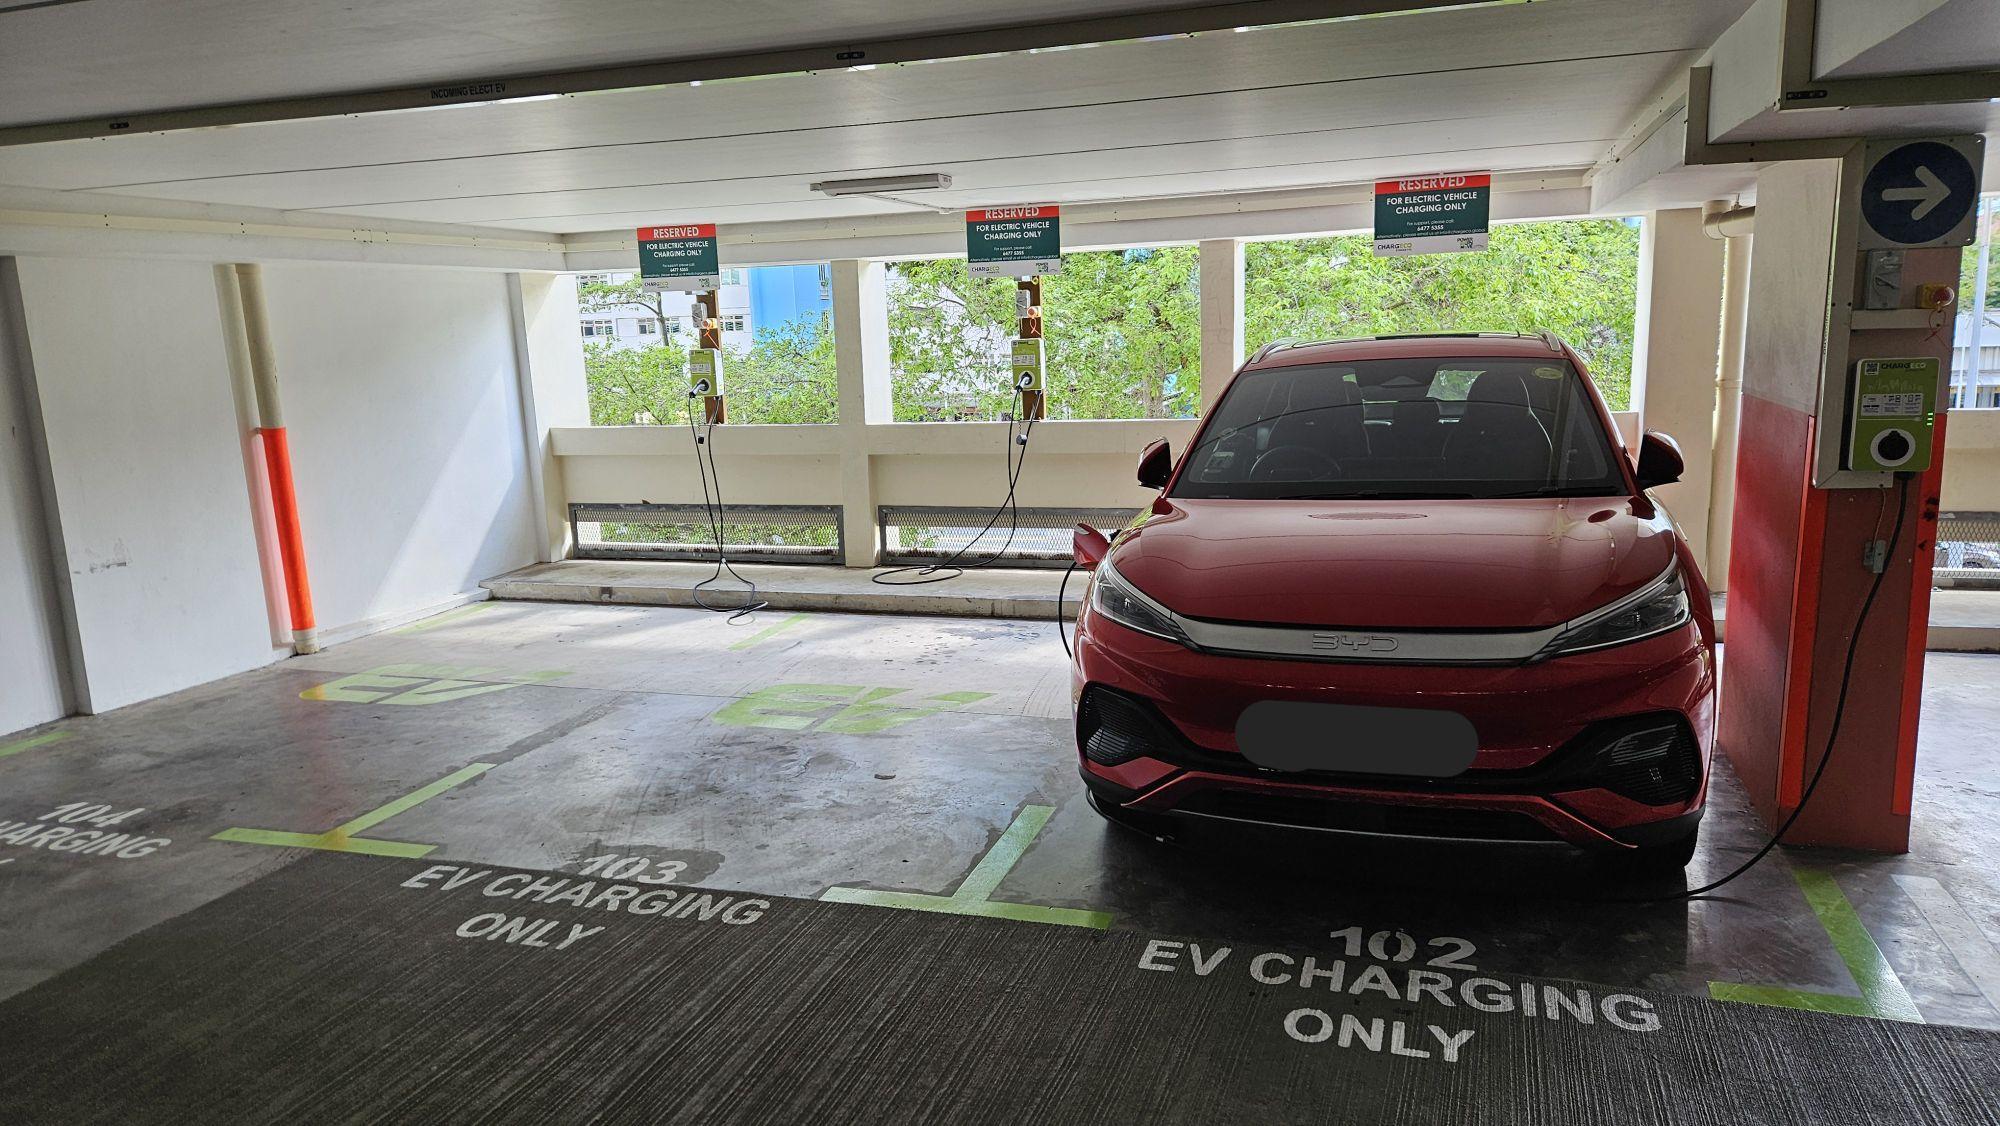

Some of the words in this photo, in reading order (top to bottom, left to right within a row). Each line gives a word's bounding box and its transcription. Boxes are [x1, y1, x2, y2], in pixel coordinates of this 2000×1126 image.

[430, 86, 468, 99] INCOMING
[468, 83, 494, 96] ELECT
[495, 82, 506, 93] EV
[1398, 176, 1466, 191] RESERVED
[1386, 198, 1403, 206] FOR
[1404, 194, 1441, 204] ELECTRIC
[1443, 191, 1478, 200] VEHICLE
[985, 207, 1039, 219] RESERVED
[1395, 204, 1442, 214] CHARGING
[1443, 202, 1467, 211] ONLY
[653, 226, 699, 239] RESERVED
[990, 223, 1021, 231] ELECTRIC
[1022, 221, 1050, 229] VEHICLE
[984, 231, 1022, 240] CHARGING
[1023, 230, 1042, 238] ONLY
[658, 242, 684, 250] ELECTRIC
[685, 240, 709, 248] VEHICLE
[1377, 242, 1412, 251] CHARGECO
[653, 250, 686, 258] CHARGING
[1312, 632, 1399, 652] BYD
[299, 663, 576, 706] EV
[711, 683, 995, 734] EV
[36, 801, 146, 828] 104
[576, 853, 688, 884] 103
[400, 864, 493, 891] EV
[482, 872, 771, 926] CHARGING
[455, 912, 606, 950] ONLY
[1329, 926, 1479, 971] 102
[1137, 938, 1232, 977] EV
[1249, 951, 1663, 1033] CHARGING
[1282, 1007, 1476, 1063] ONLY
